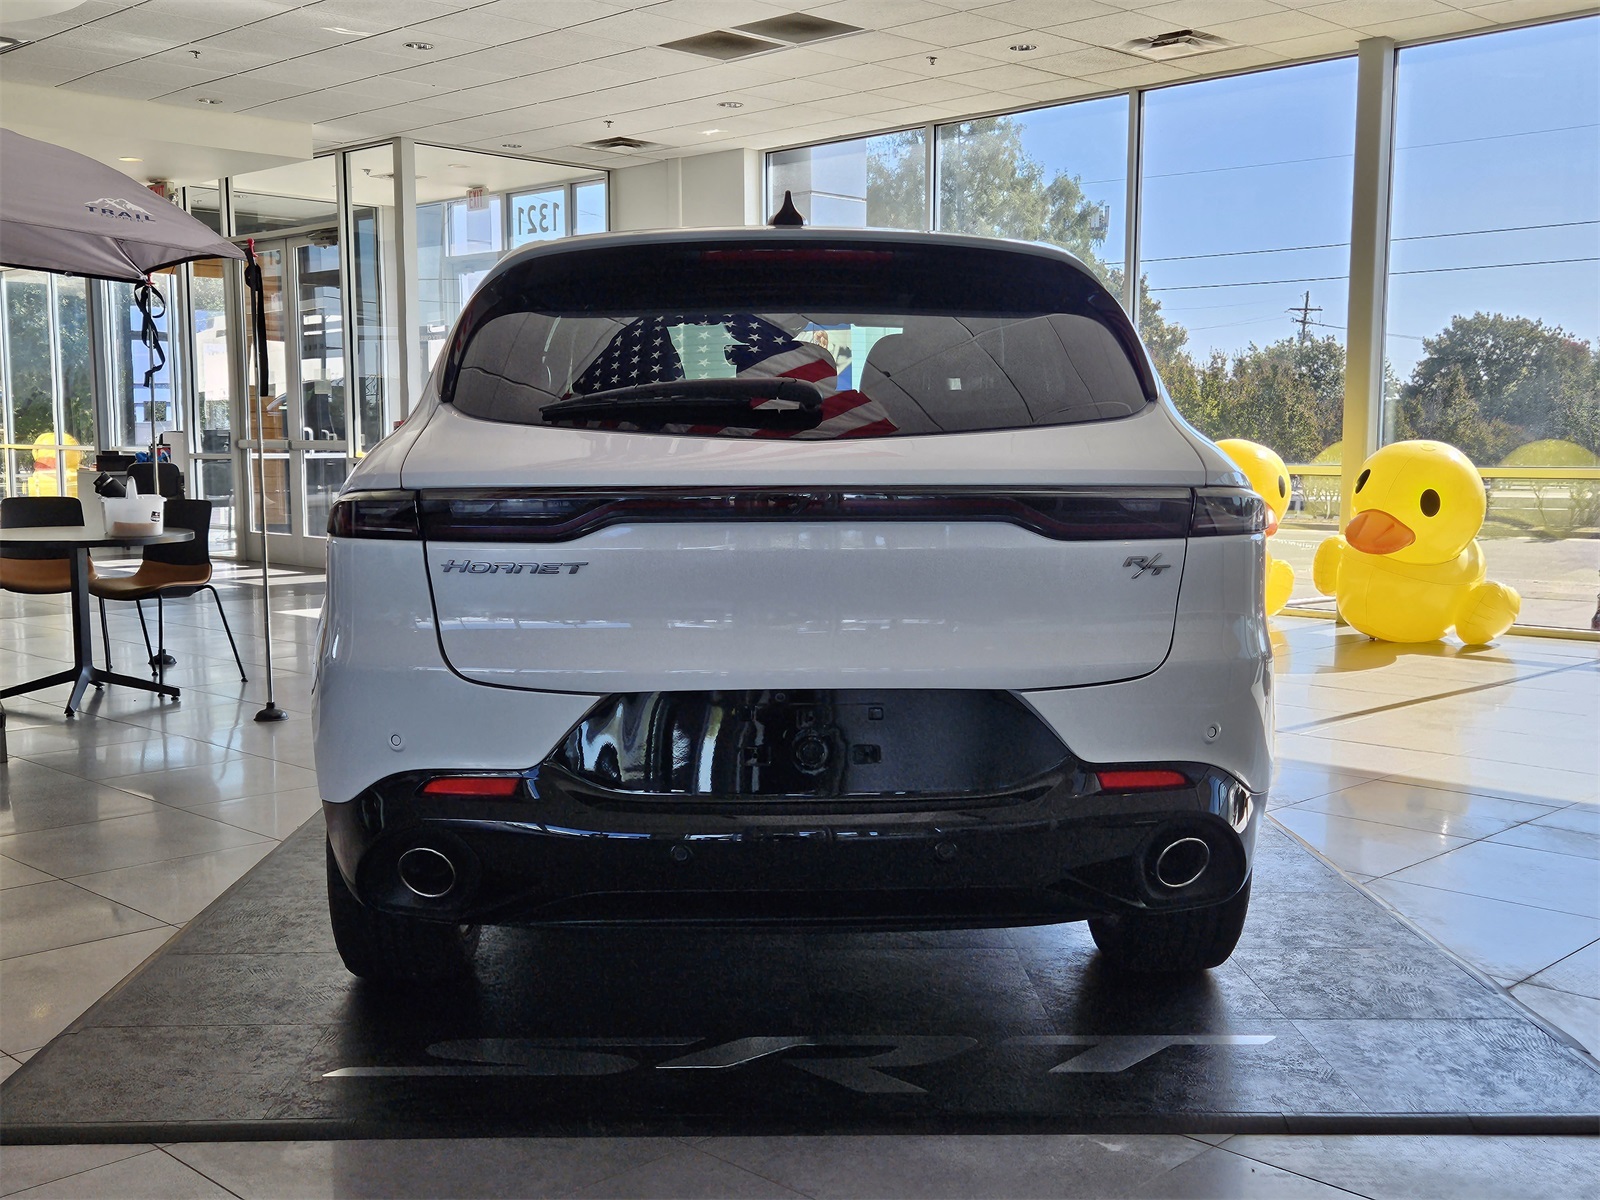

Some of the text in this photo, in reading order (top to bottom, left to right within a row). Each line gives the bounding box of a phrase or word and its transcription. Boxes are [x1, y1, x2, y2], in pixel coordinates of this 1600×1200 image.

[468, 189, 483, 209] EXIT
[85, 205, 156, 222] TRAIL
[440, 559, 589, 575] HORNET
[1122, 552, 1171, 579] R/T
[322, 1034, 1277, 1094] SRT
